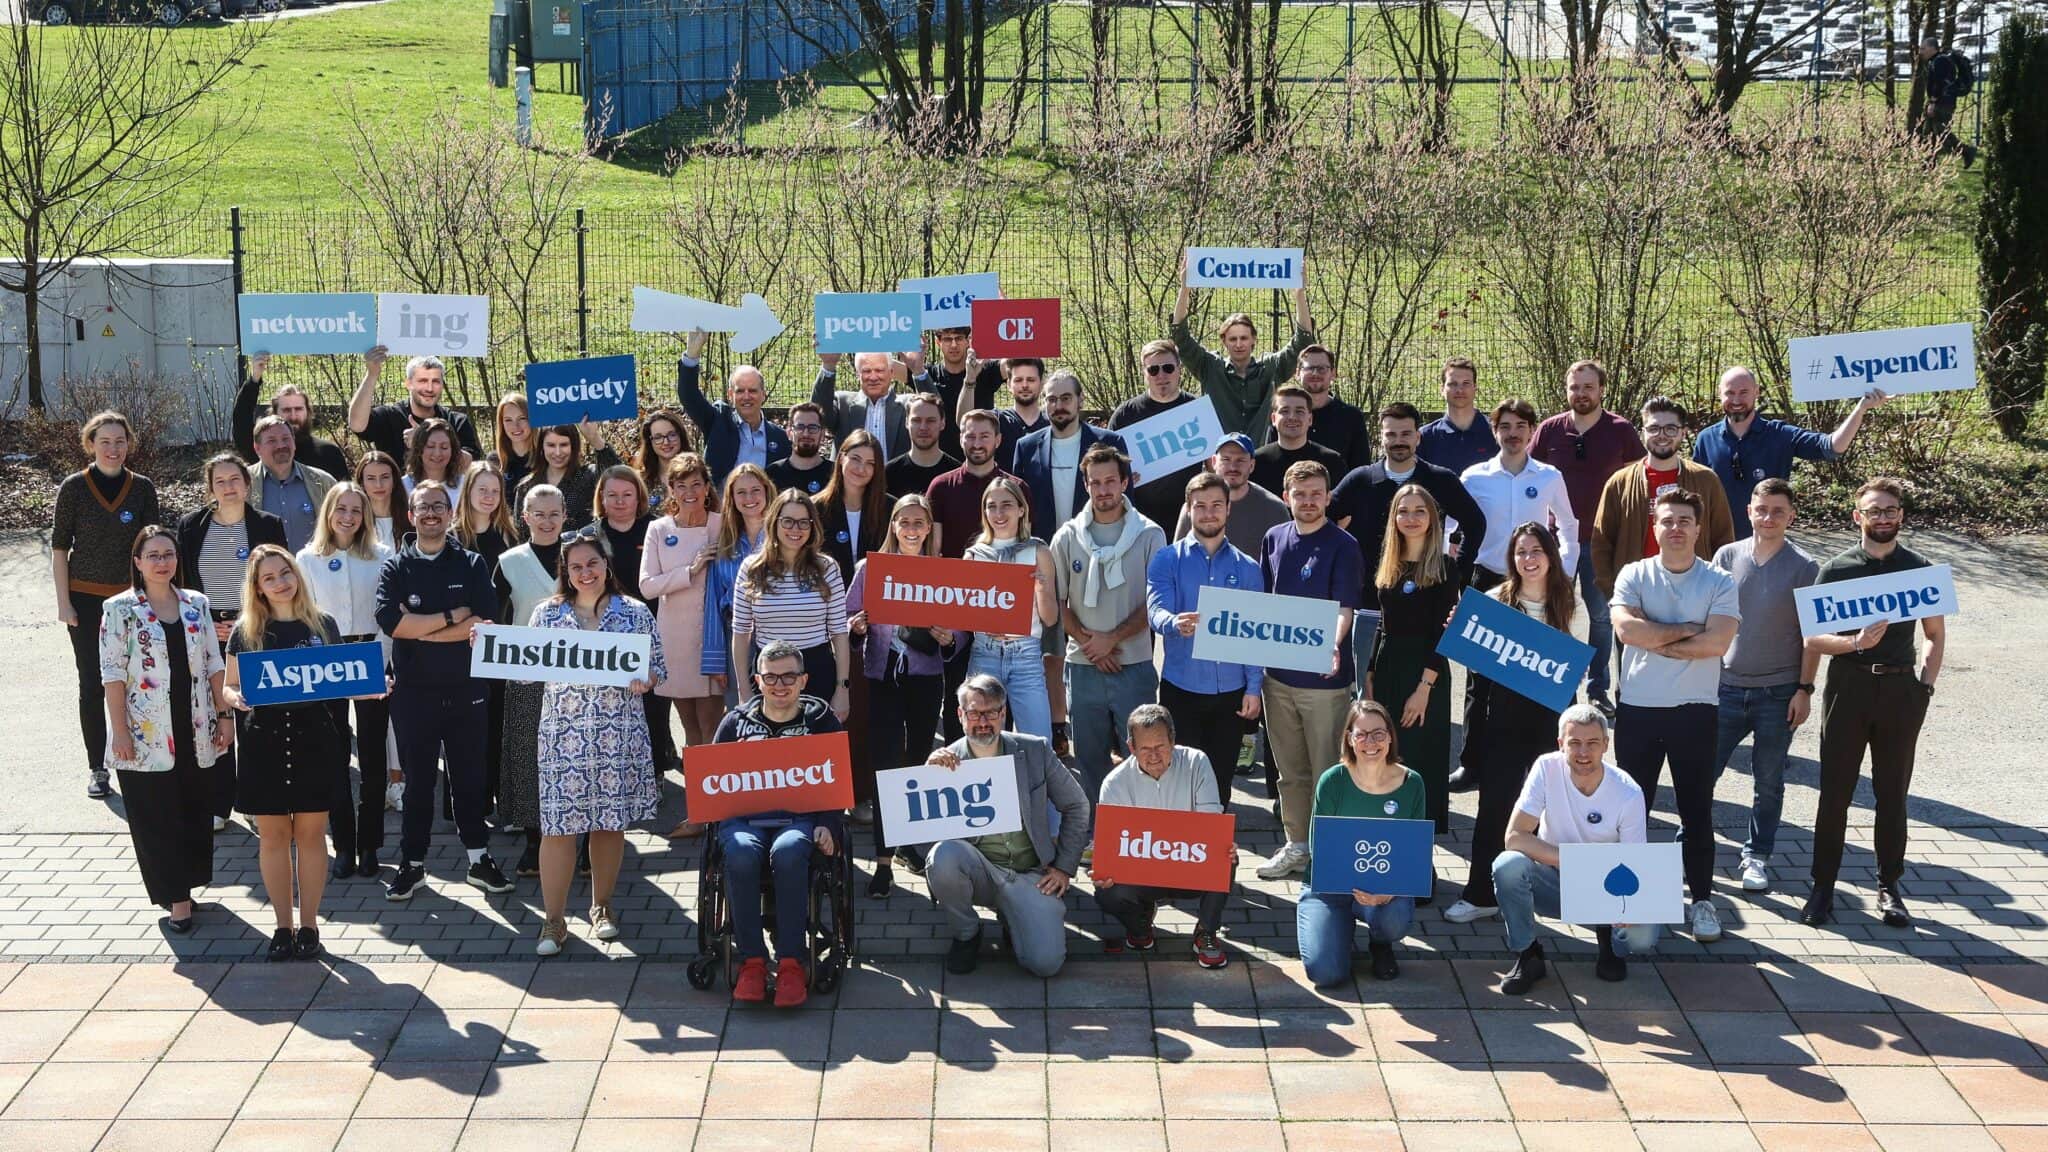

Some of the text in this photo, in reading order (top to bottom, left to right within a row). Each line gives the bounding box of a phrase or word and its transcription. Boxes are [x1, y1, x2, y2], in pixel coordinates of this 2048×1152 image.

[1197, 257, 1292, 280] Central
[924, 290, 975, 312] Let's
[250, 311, 367, 335] network
[398, 303, 470, 350] ing
[824, 310, 913, 340] people
[997, 318, 1034, 341] CE
[1830, 345, 1959, 384] AspenCE
[535, 377, 629, 405] society
[1135, 415, 1209, 466] ing
[882, 575, 1016, 610] innovate
[1812, 585, 1941, 624] Europe
[1207, 610, 1324, 647] discuss
[481, 633, 641, 673] Institute
[1461, 614, 1571, 684] impact
[256, 659, 369, 694] Aspen
[702, 758, 835, 795] connect
[904, 777, 996, 828] ing
[1118, 829, 1207, 863] ideas
